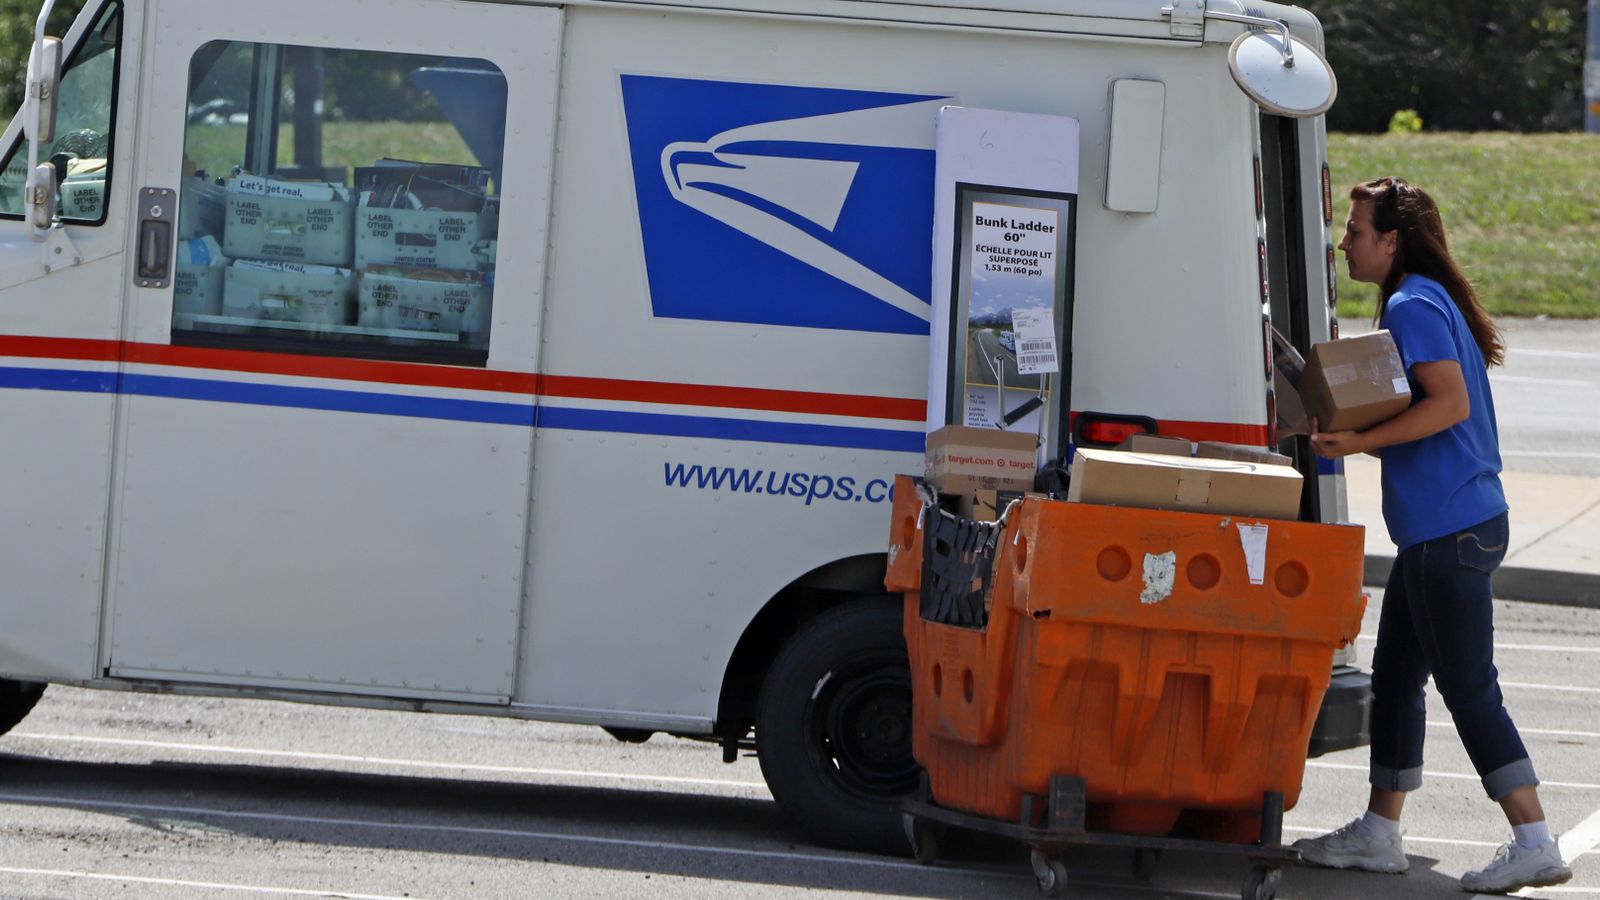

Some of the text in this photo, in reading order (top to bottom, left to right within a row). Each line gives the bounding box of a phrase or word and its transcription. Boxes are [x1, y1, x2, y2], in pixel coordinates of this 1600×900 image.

[240, 180, 263, 191] Let's
[265, 185, 281, 194] get
[73, 189, 98, 197] LABEL
[73, 196, 99, 205] OTHER
[79, 204, 96, 213] END
[236, 201, 261, 210] LABEL
[235, 209, 262, 218] OTHER
[307, 208, 333, 216] LABEL
[240, 217, 257, 225] END
[306, 215, 334, 224] OTHER
[368, 214, 393, 222] LABEL
[439, 218, 465, 226] LABEL
[311, 223, 328, 231] END
[367, 222, 394, 230] OTHER
[975, 216, 1055, 233] Bunk Ladder
[372, 230, 388, 238] END
[438, 226, 466, 234] OTHER
[1004, 232, 1026, 242] 60"
[975, 244, 1012, 255] ÉCHELLE
[1014, 249, 1038, 258] POUR
[989, 255, 1039, 267] SUPERPOSÉ
[985, 264, 1002, 272] 1,53
[1013, 267, 1027, 275] (60
[1028, 268, 1042, 277] po)
[373, 284, 398, 293] LABEL
[372, 291, 398, 300] OTHER
[376, 299, 393, 308] END
[443, 297, 470, 305] OTHER
[448, 304, 465, 312] END
[948, 455, 993, 465] target.com
